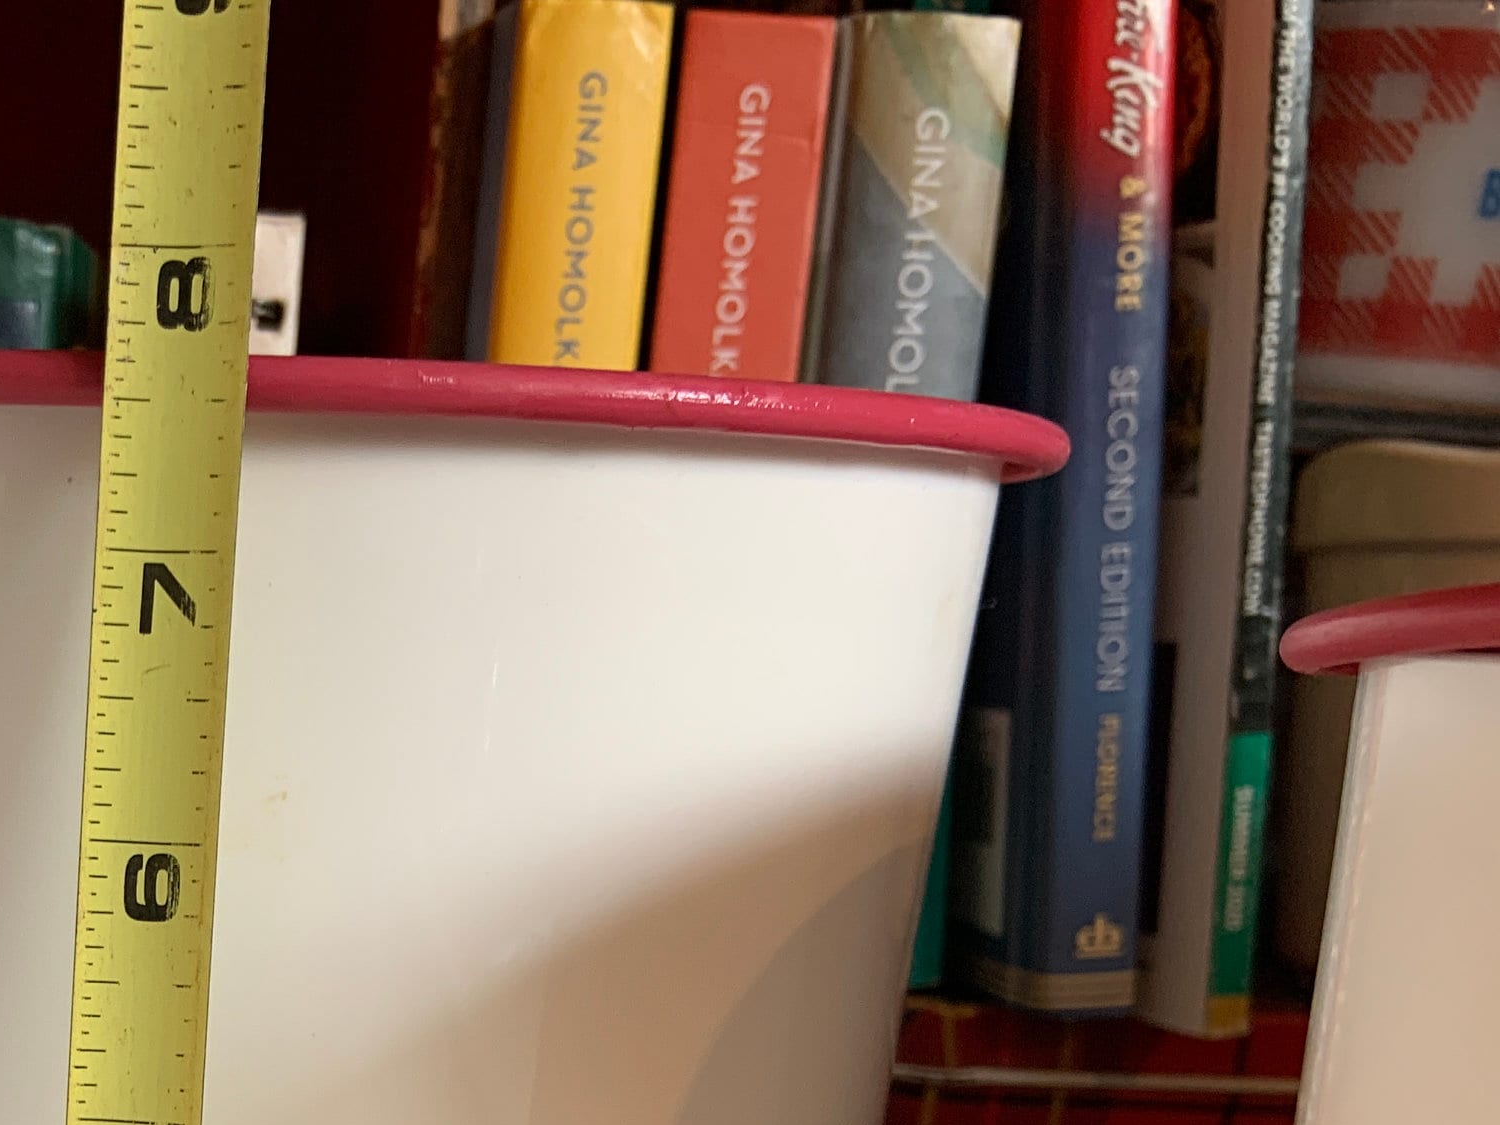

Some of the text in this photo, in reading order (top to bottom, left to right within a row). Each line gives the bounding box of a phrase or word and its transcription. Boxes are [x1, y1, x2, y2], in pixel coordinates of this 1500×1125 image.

[571, 71, 608, 171] GINA
[906, 107, 951, 219] GINA
[708, 84, 772, 377] GINA HOMOLK
[1119, 175, 1147, 199] &
[156, 256, 214, 332] 8
[1115, 212, 1146, 312] MORE
[1102, 365, 1141, 532] SECOND
[139, 562, 197, 635] 7
[1095, 541, 1134, 692] EDITION
[123, 853, 181, 923] 6
